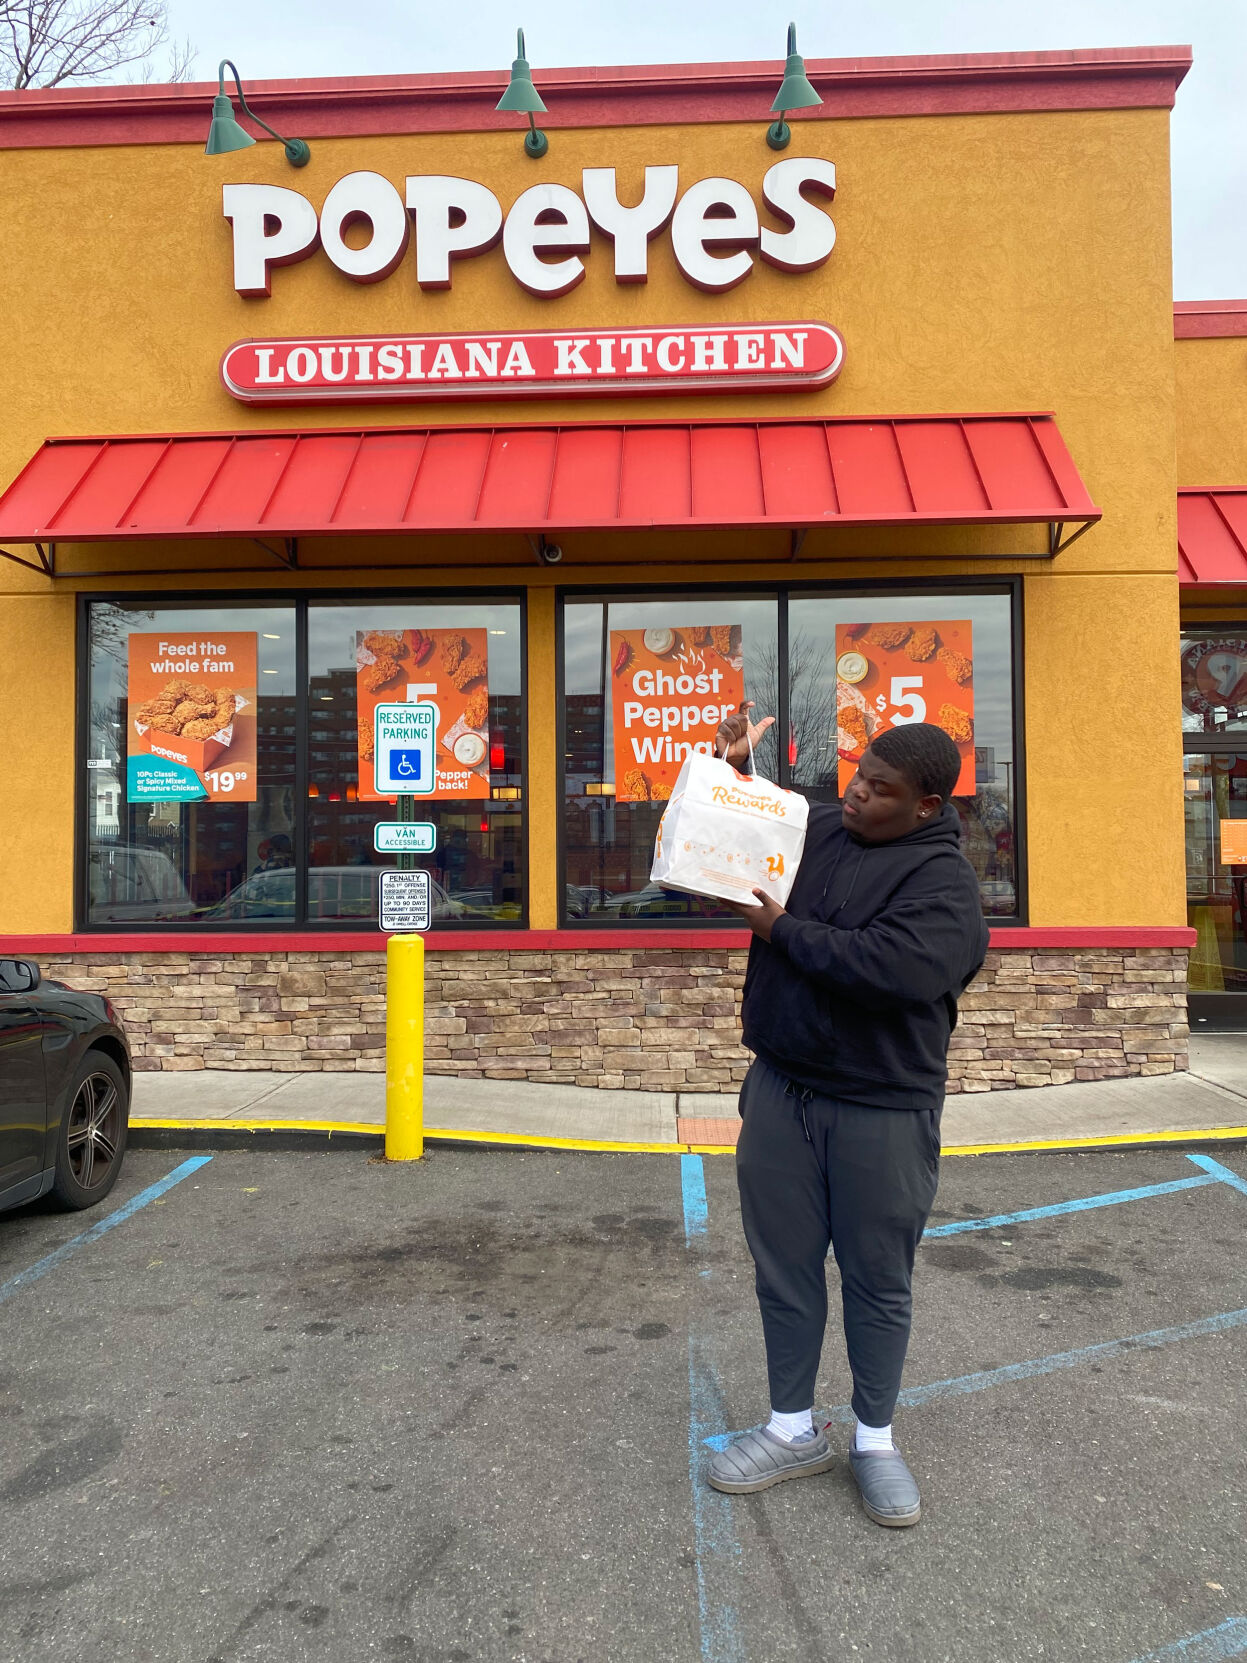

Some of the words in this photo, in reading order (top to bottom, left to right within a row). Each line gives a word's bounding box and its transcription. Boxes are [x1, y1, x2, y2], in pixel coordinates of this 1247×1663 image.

[254, 340, 536, 384] LOUISIANA
[553, 332, 808, 375] KITCHEN
[158, 642, 197, 655] Feed
[199, 642, 227, 655] the
[150, 659, 199, 673] whole
[202, 659, 234, 673] fam
[632, 668, 724, 697] Ghost
[875, 675, 927, 726] $5
[379, 712, 432, 724] RESERVED
[623, 701, 735, 732] Pepper
[383, 728, 428, 739] PARKING
[136, 784, 171, 792] Signature
[171, 784, 199, 792] Chicken
[146, 778, 164, 787] Spicy
[438, 780, 468, 790] back!
[711, 786, 787, 817] Rewards
[395, 829, 416, 838] VAN
[389, 874, 421, 882] PENALTY
